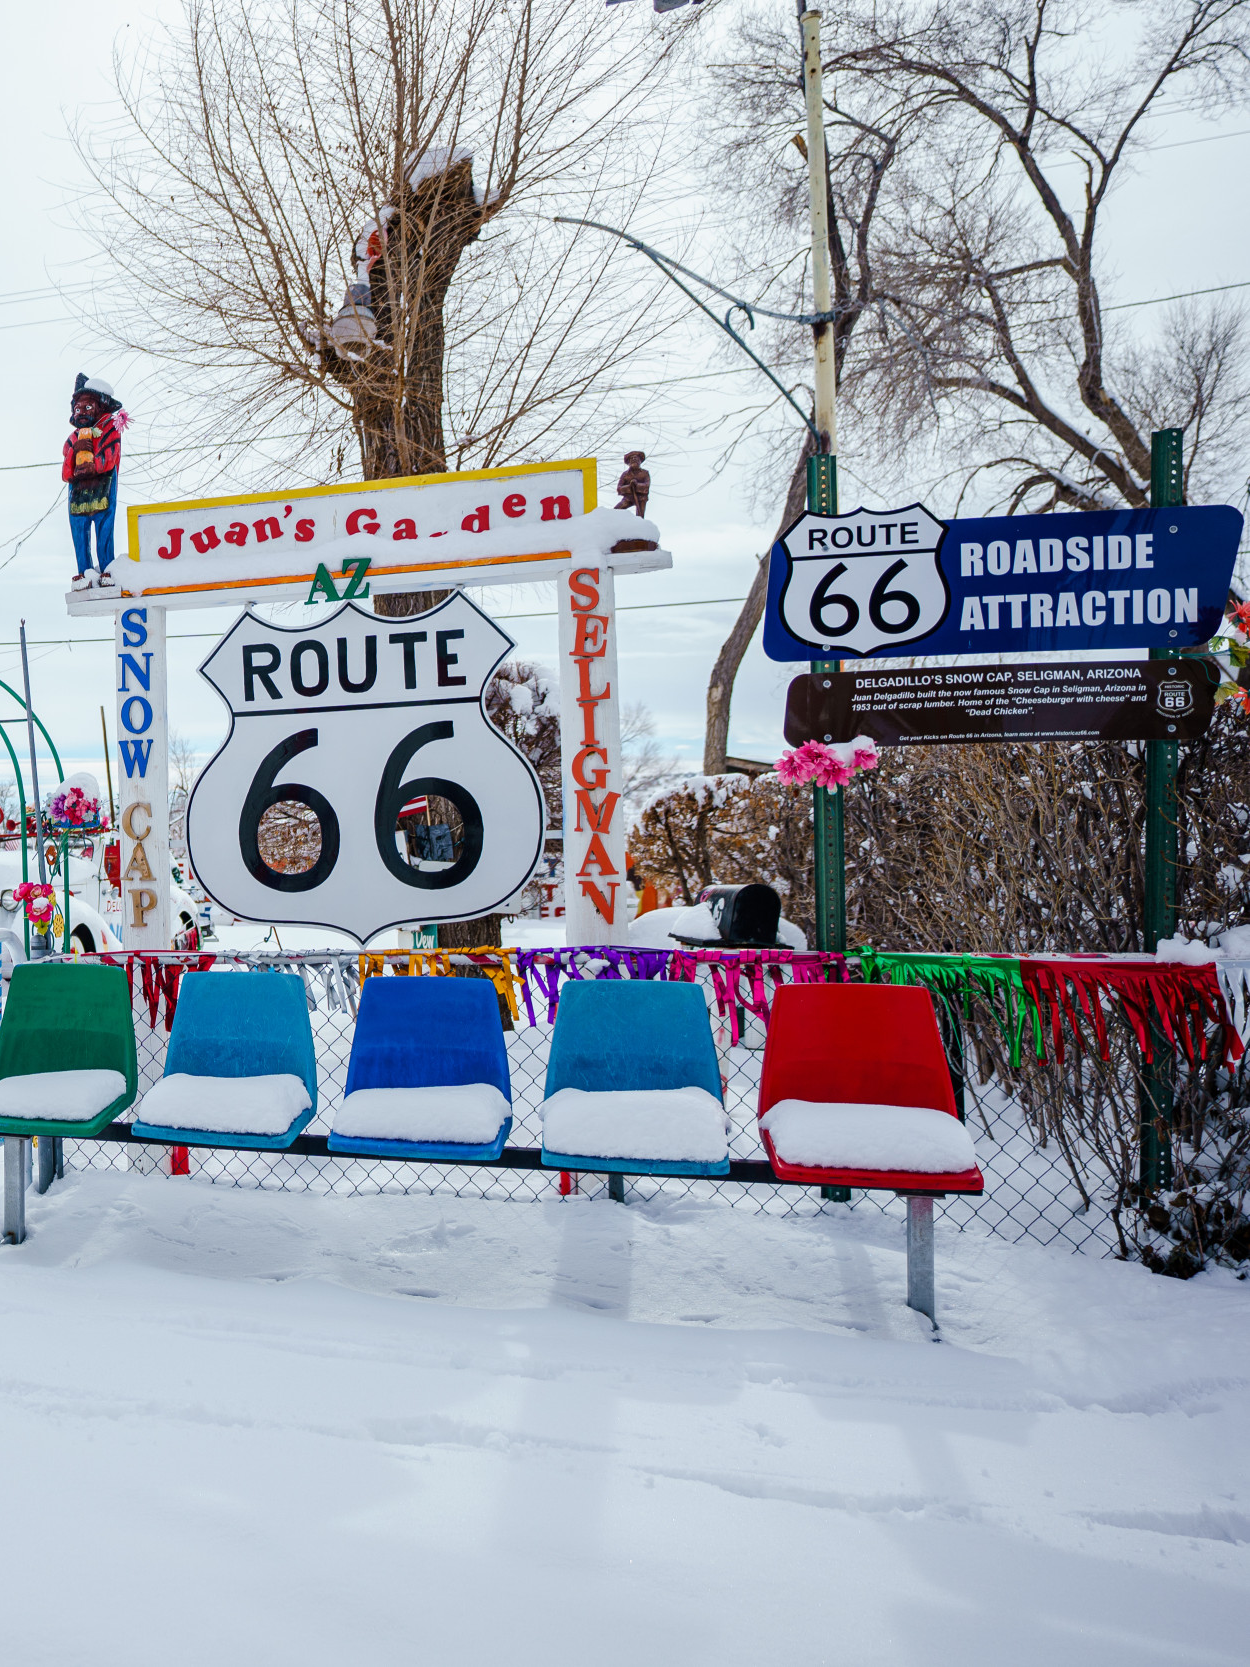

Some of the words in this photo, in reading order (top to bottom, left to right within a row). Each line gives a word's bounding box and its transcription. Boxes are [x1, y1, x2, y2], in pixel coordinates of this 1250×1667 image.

[157, 504, 316, 560] Juan's
[345, 492, 573, 541] Gaden
[807, 521, 920, 551] ROUTE
[960, 533, 1154, 577] ROADSIDE
[304, 557, 372, 606] AZ
[809, 557, 921, 638] 66
[959, 587, 1199, 632] ATTRACTION
[241, 628, 467, 702] ROUTE
[855, 674, 943, 689] DELGADILLO'S
[945, 672, 984, 684] SNOW
[986, 672, 1014, 683] CAP,
[1017, 670, 1084, 681] SELIGMAN,
[1086, 668, 1142, 679] ARIZONA
[117, 607, 154, 779] SNOW
[851, 694, 872, 702] Juan
[873, 691, 916, 702] Delgadillo
[916, 690, 937, 699] built
[937, 689, 952, 698] the
[953, 689, 972, 697] now
[973, 688, 1006, 696] famous
[1007, 686, 1031, 695] Snow
[1033, 685, 1050, 695] Cap
[1051, 685, 1060, 694] in
[1062, 684, 1102, 695] Seligman,
[1103, 684, 1136, 692] Arizona
[1137, 683, 1147, 692] in
[851, 703, 871, 712] 1953
[872, 703, 887, 711] out
[888, 702, 898, 710] of
[898, 701, 922, 710] scrap
[923, 700, 956, 708] lumber.
[957, 699, 983, 707] Home
[984, 698, 994, 706] of
[995, 697, 1010, 705] the
[1076, 695, 1094, 703] with
[1131, 694, 1148, 702] and
[1164, 696, 1185, 708] 66
[568, 567, 622, 925] SELIGMAN
[238, 719, 485, 893] 66
[120, 801, 158, 928] CAP
